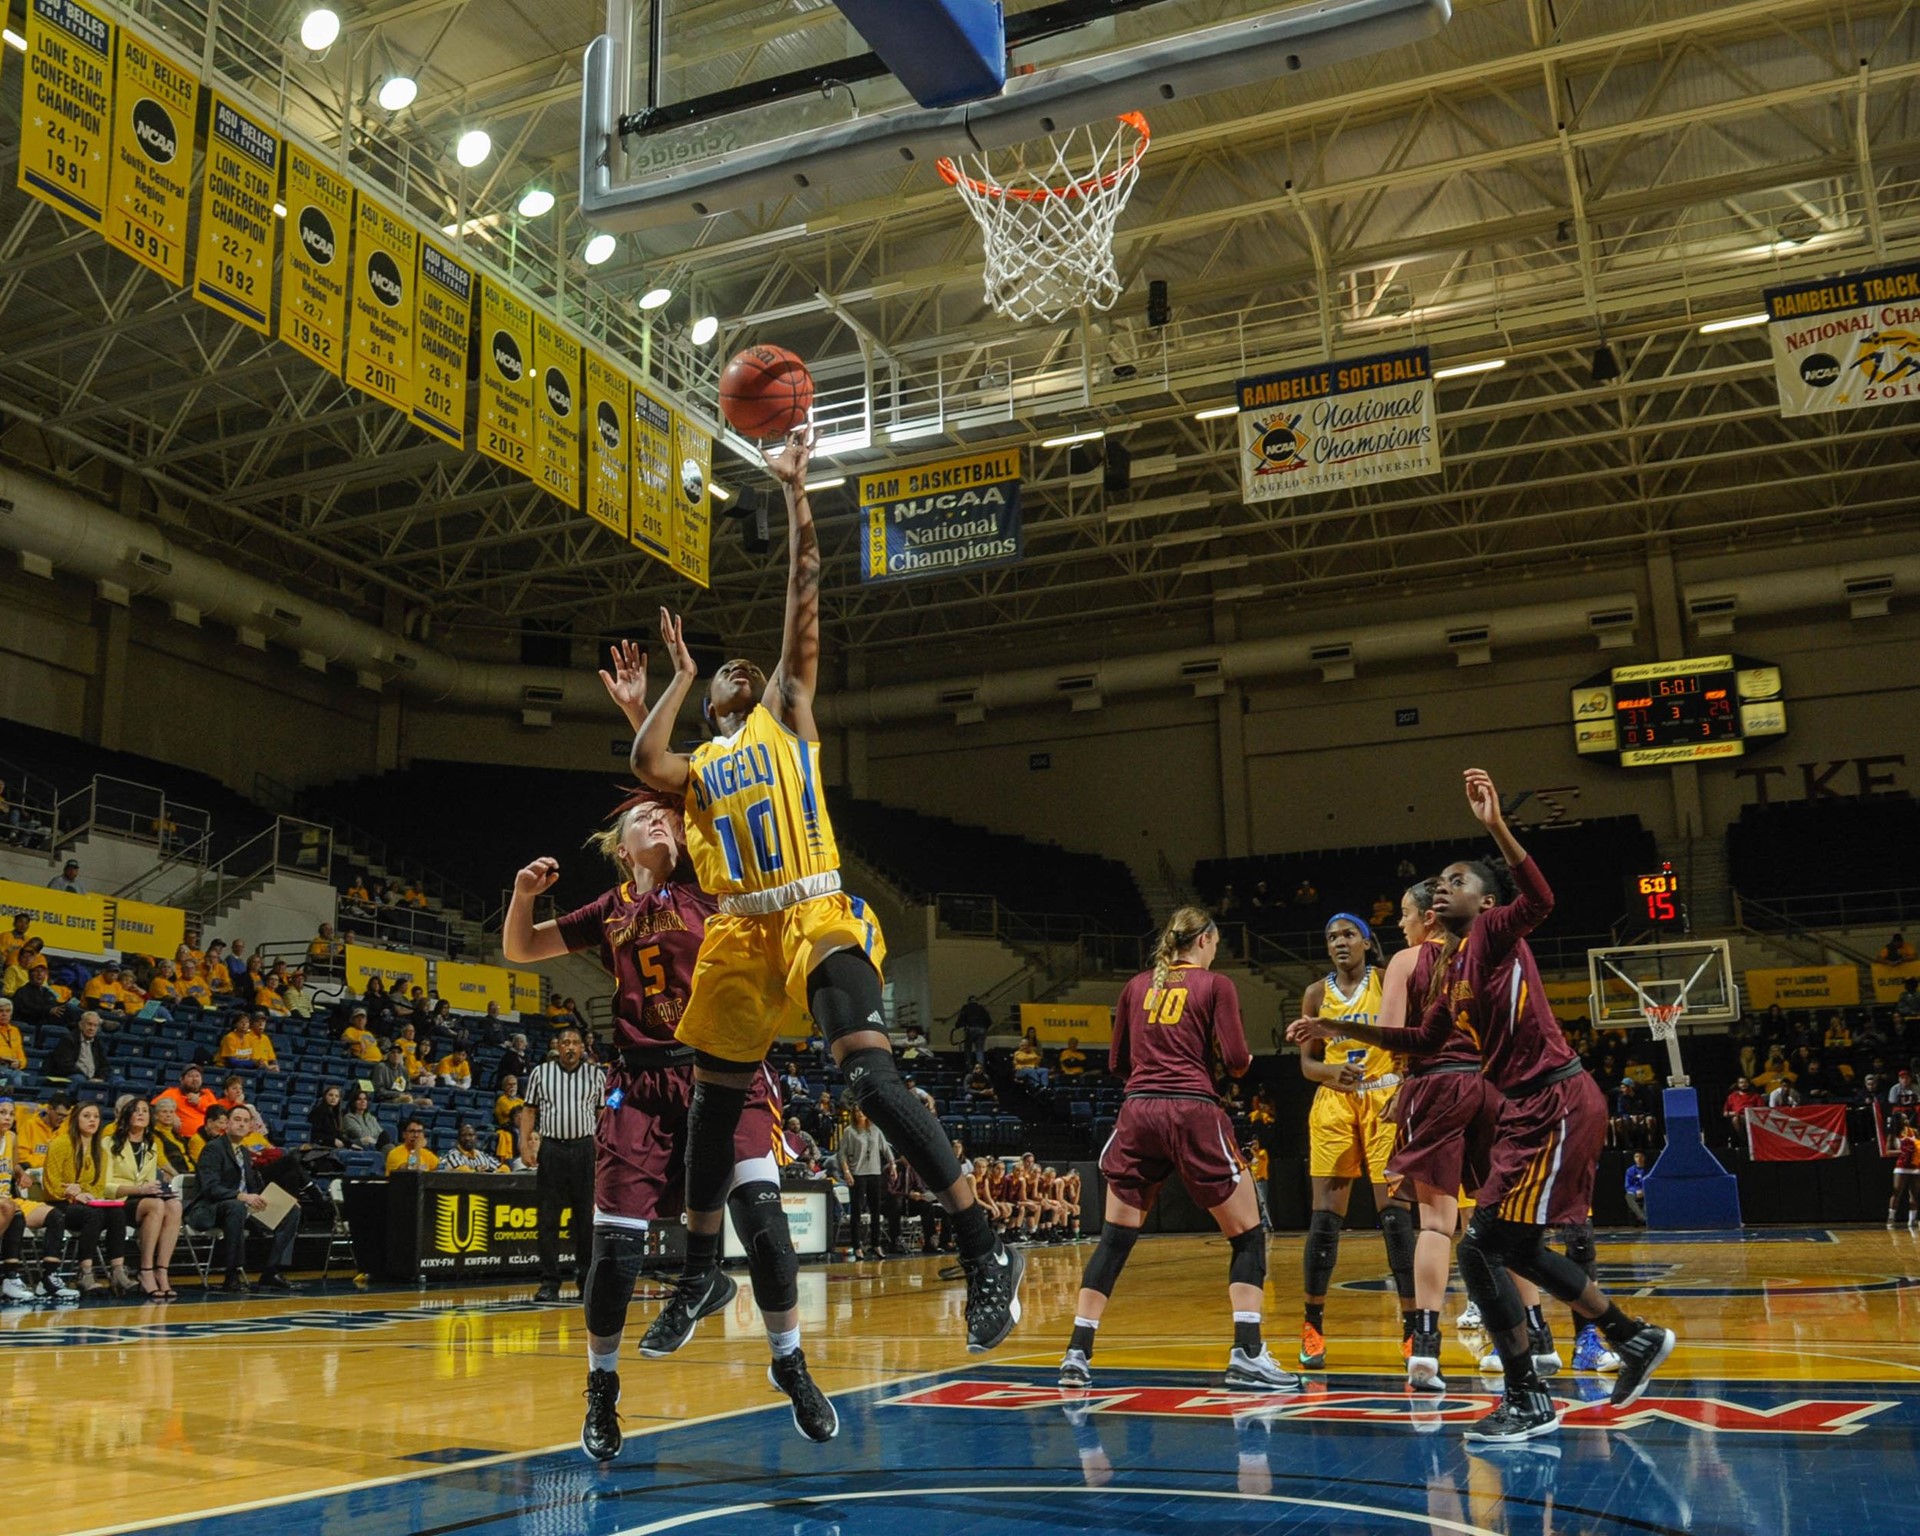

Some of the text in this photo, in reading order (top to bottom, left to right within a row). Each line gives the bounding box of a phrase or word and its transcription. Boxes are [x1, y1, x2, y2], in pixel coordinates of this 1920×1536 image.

[39, 0, 102, 50] VOLLEYBALL
[38, 31, 102, 88] LONE STAR
[125, 40, 147, 71] ASU
[31, 52, 106, 118] CONFERENCE
[37, 80, 100, 138] CHAMPION
[219, 104, 238, 128] ASU
[46, 118, 88, 159] 24-17
[136, 118, 174, 158] NCAA
[218, 122, 270, 165] VOLLEYBALL
[46, 147, 86, 190] 1991
[120, 145, 184, 201] South Central
[215, 151, 269, 201] LONE STAR
[292, 154, 310, 180] ASU
[134, 174, 165, 208] Region
[208, 172, 272, 227] CONFERENCE
[133, 196, 164, 229] 24-17
[211, 198, 265, 246] CHAMPION
[361, 201, 378, 226] ASU
[123, 219, 168, 265] 1991
[222, 234, 252, 265] 22-7
[301, 224, 334, 259] NCAA
[425, 246, 440, 268] ASU
[216, 258, 254, 296] 1992
[301, 277, 327, 306] Region
[312, 266, 342, 298] Central
[370, 269, 401, 300] NCAA
[423, 290, 464, 330] LONE STAR
[1773, 273, 1920, 317] RAMBELLE TRACK
[292, 317, 330, 358] 1992
[419, 308, 467, 353] CONFERENCE
[1785, 314, 1874, 353] NATIONAL
[421, 331, 462, 371] CHAMPION
[495, 346, 521, 375] NCAA
[365, 363, 395, 395] 2011
[1243, 356, 1426, 407] RAMBELLE SOFTBALL
[1805, 366, 1841, 381] NCAA
[424, 385, 451, 417] 2012
[547, 383, 570, 411] NCAA
[1312, 390, 1423, 432] National
[489, 431, 523, 463] 2012
[599, 417, 620, 443] NCAA
[1313, 426, 1431, 464] Champions
[1266, 442, 1296, 455] NCAA
[866, 458, 1013, 500] RAM BASKETBALL
[1251, 457, 1432, 496] ANGELO STATE UNIVERSITY
[597, 496, 619, 524] 2014
[894, 487, 1006, 523] NJCAA
[642, 512, 662, 538] 2015
[904, 513, 998, 546] National
[680, 549, 700, 575] 2015
[889, 537, 1016, 572] Champions
[1660, 679, 1696, 695] 6:01
[712, 798, 785, 882] 10
[1639, 876, 1677, 894] 6:01
[43, 911, 96, 930] REAL ESTATE
[1648, 892, 1675, 919] 15
[638, 944, 666, 997] 5
[1043, 1018, 1090, 1028] TEXAS BANK
[1143, 987, 1188, 1024] 40
[420, 1257, 454, 1268] KIXY-FM
[464, 1256, 501, 1266] KWFR-FM
